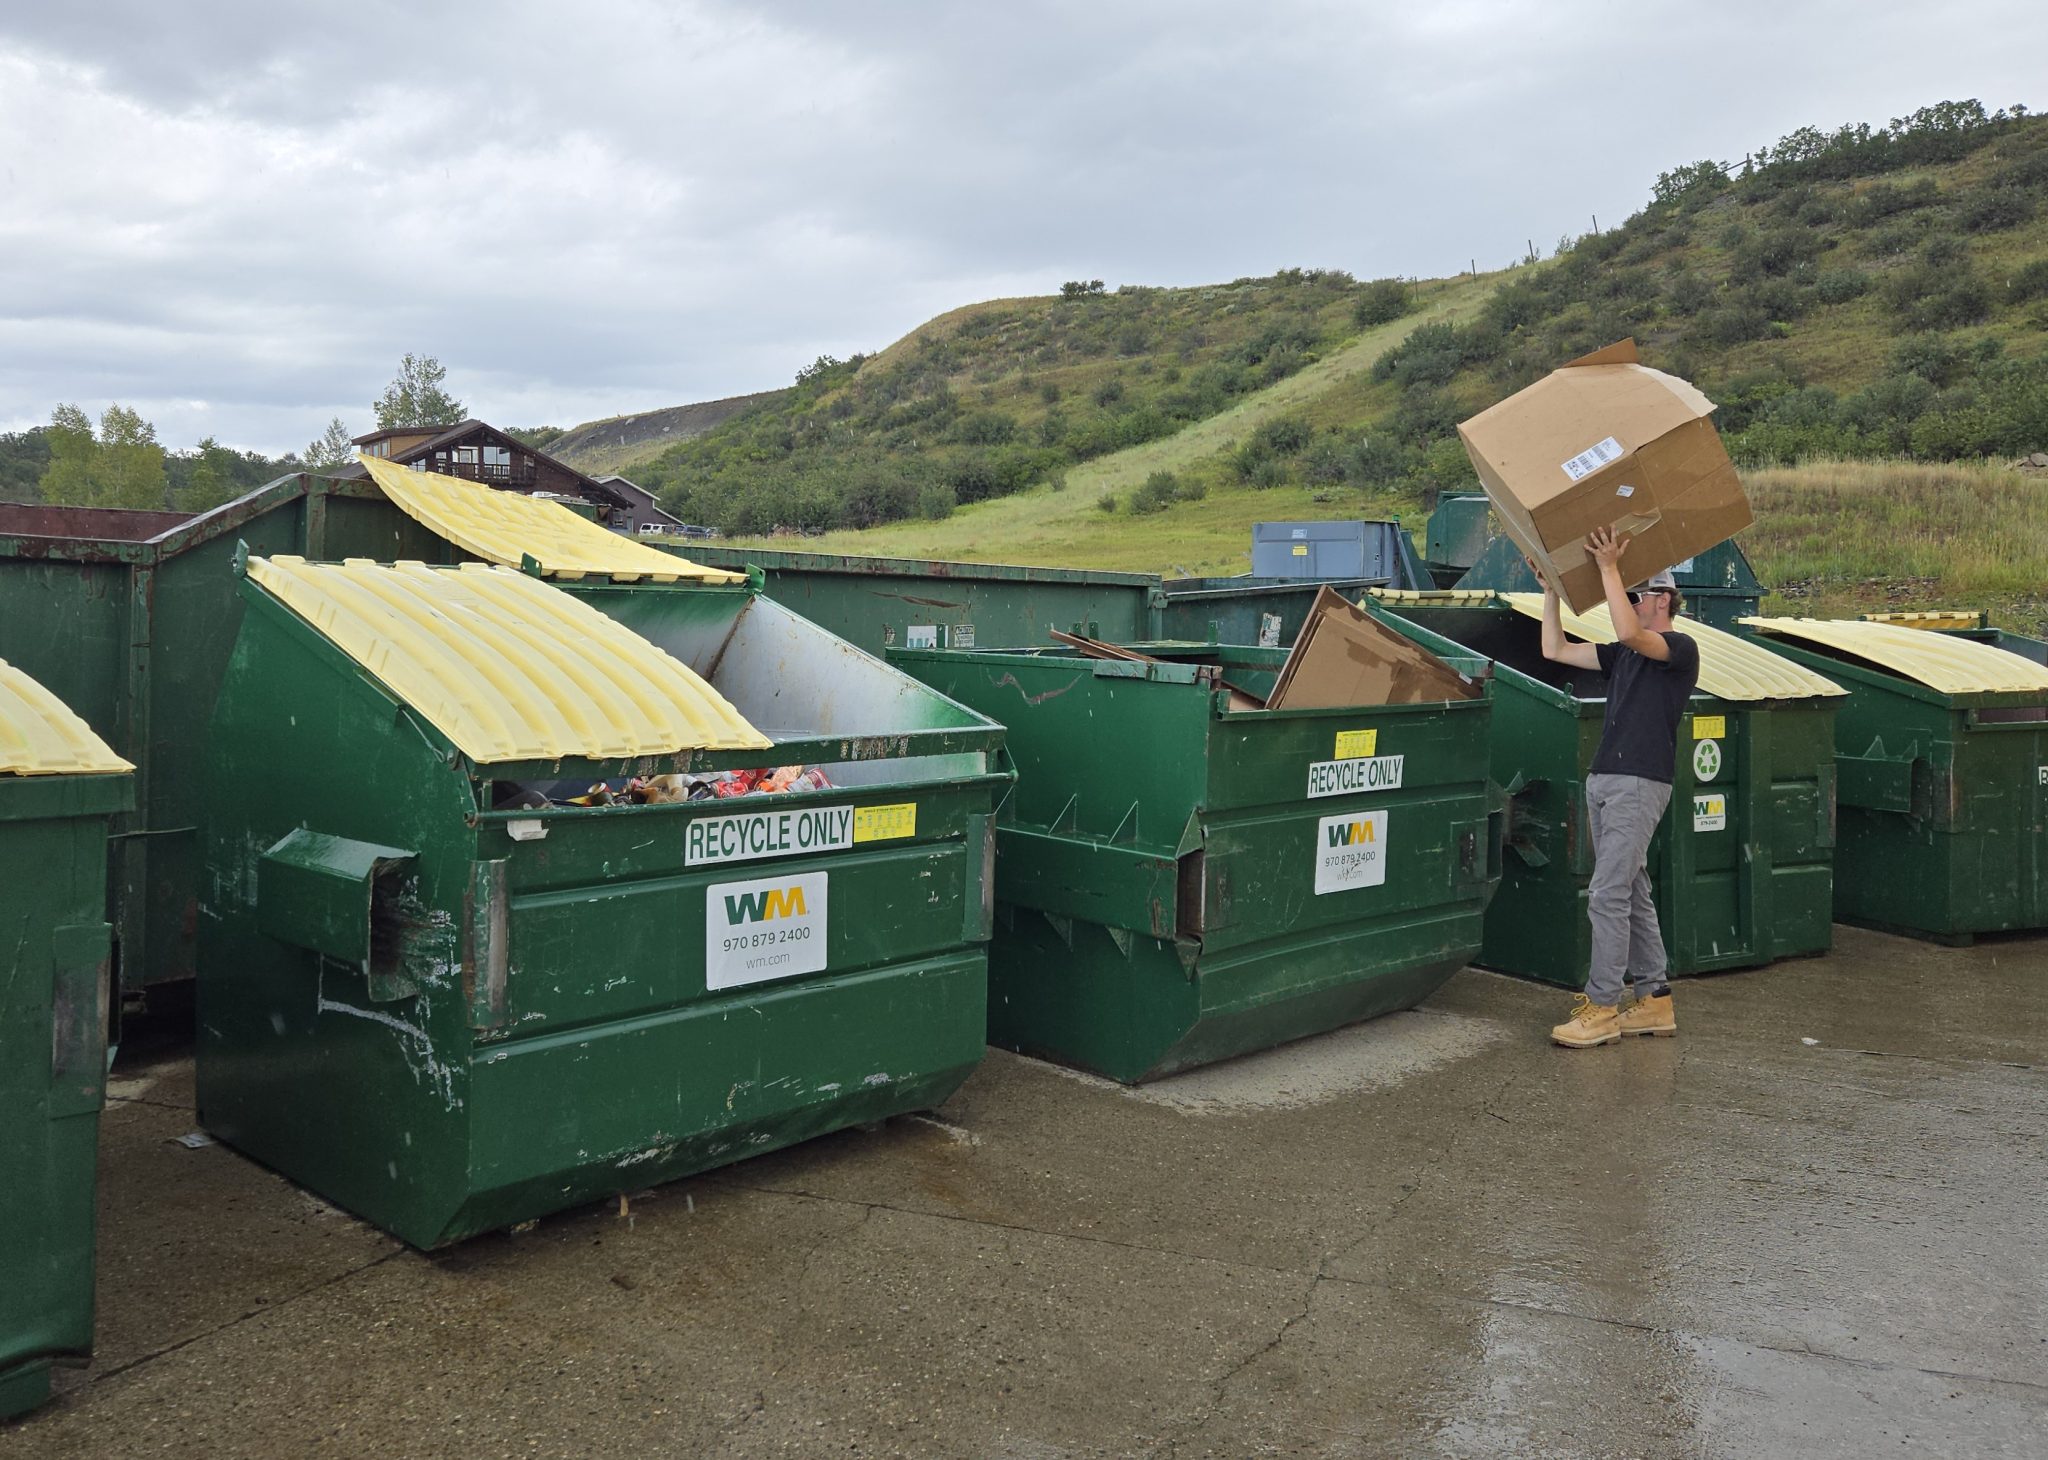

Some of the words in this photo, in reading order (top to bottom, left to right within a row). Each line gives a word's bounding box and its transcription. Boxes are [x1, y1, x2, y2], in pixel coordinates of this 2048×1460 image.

[1311, 762, 1364, 793] RECYCLE
[1369, 759, 1401, 787] ONLY
[1693, 800, 1724, 815] WM
[689, 815, 791, 859] RECYCLE
[798, 809, 850, 848] ONLY
[1328, 820, 1374, 848] WM
[1325, 855, 1339, 868] 970
[1341, 852, 1355, 865] 879
[1356, 851, 1376, 863] 2400
[724, 886, 806, 926] WM
[723, 936, 748, 952] 970
[752, 931, 776, 947] 879
[779, 926, 810, 943] 2400
[746, 953, 790, 969] wm.com
